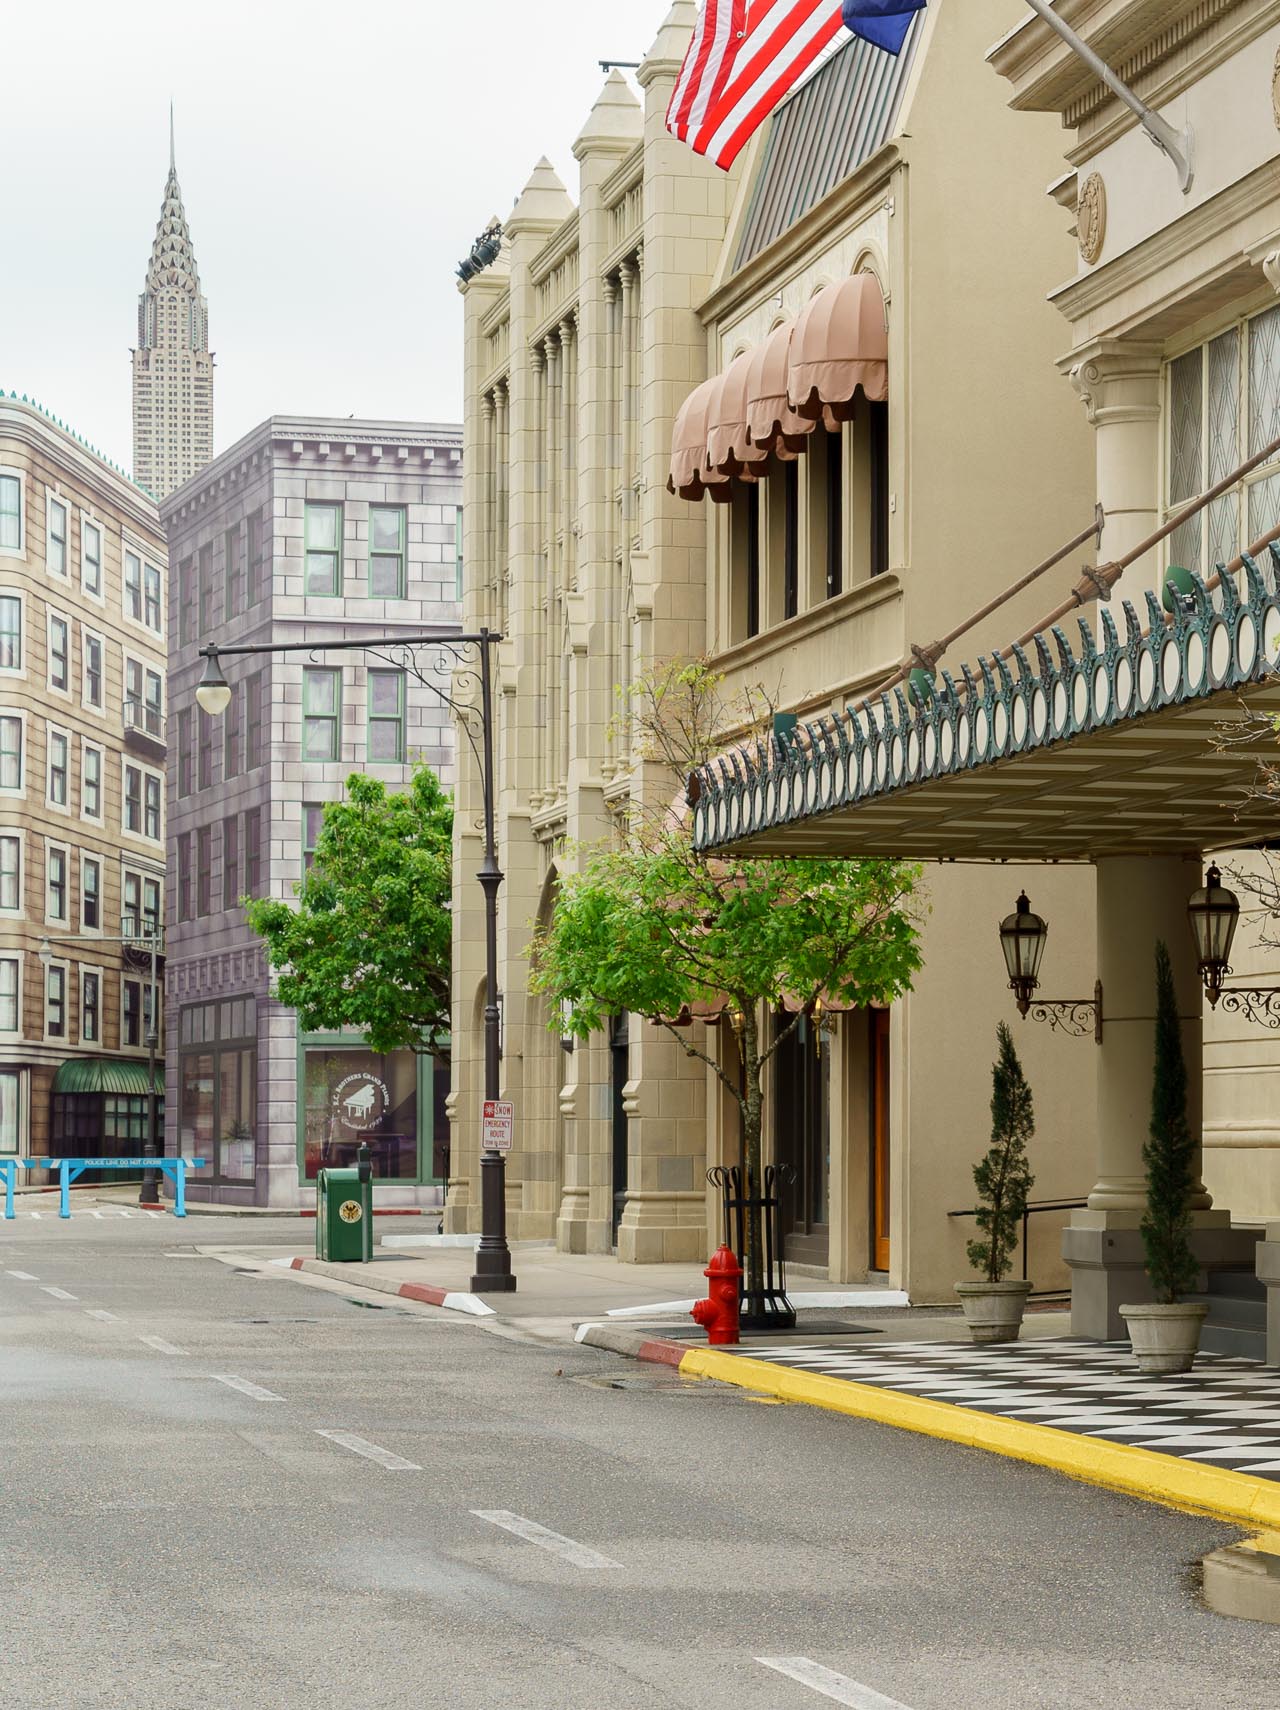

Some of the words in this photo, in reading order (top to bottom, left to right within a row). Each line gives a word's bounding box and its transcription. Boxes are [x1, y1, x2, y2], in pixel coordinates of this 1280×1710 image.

[495, 1105, 512, 1115] SNOW
[485, 1120, 510, 1128] EMERGENCY
[490, 1130, 505, 1138] ROUTE
